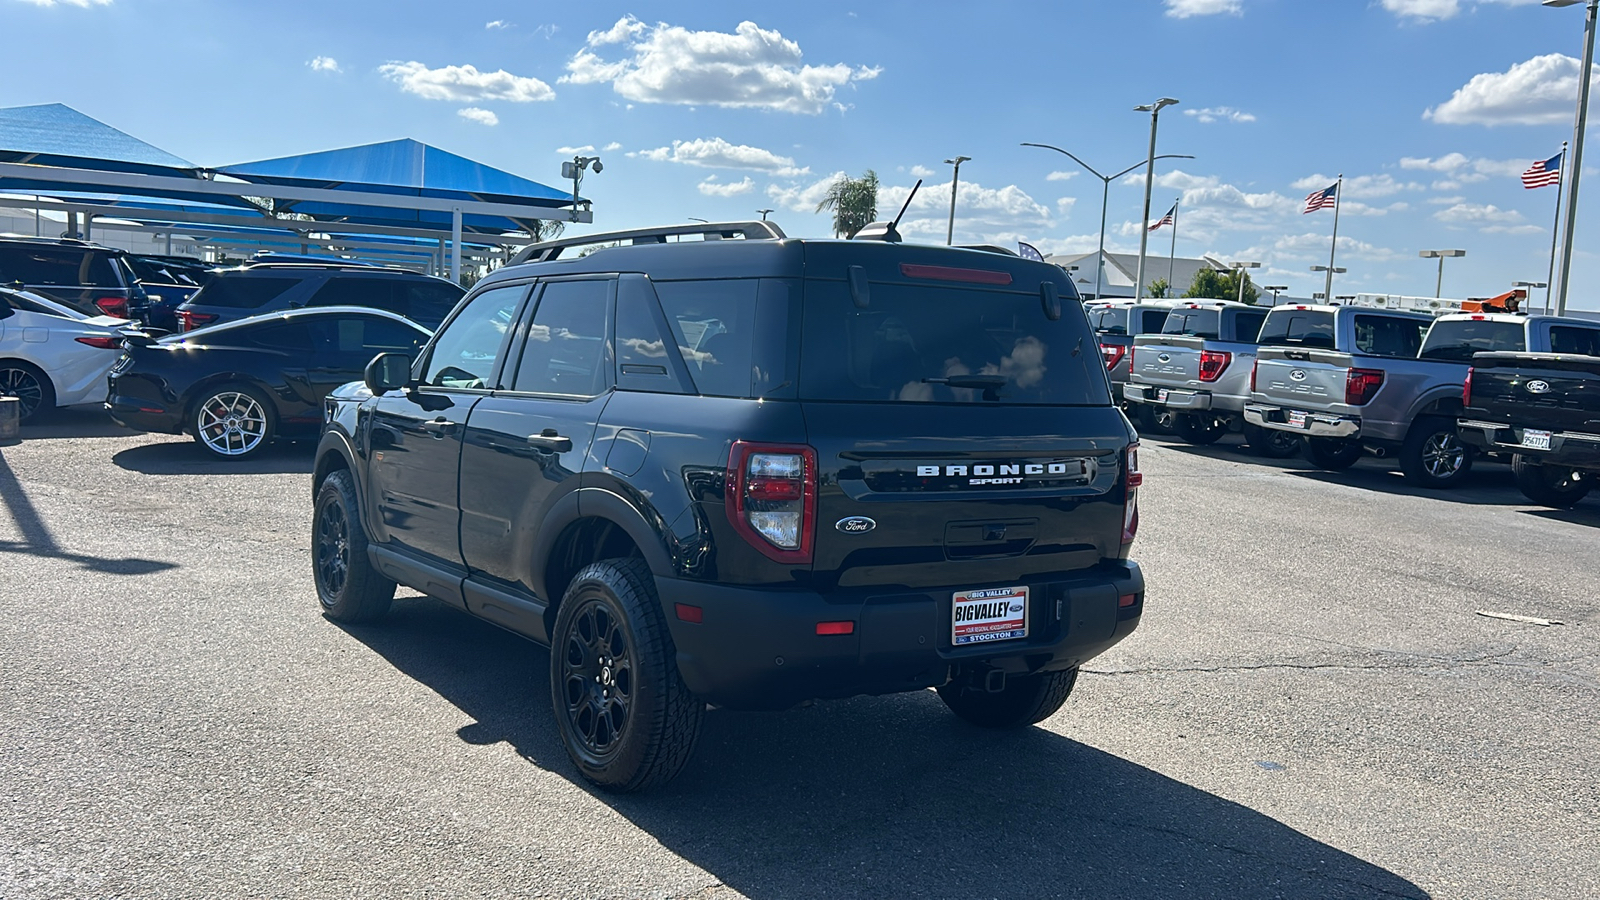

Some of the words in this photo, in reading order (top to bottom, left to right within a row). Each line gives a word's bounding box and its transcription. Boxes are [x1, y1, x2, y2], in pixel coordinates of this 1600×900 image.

[1269, 381, 1327, 396] F-150
[916, 463, 1066, 477] BRONCO
[969, 477, 1024, 485] SPORT
[955, 602, 1010, 622] BIGVALLEY
[970, 632, 1011, 642] STOCKTON
